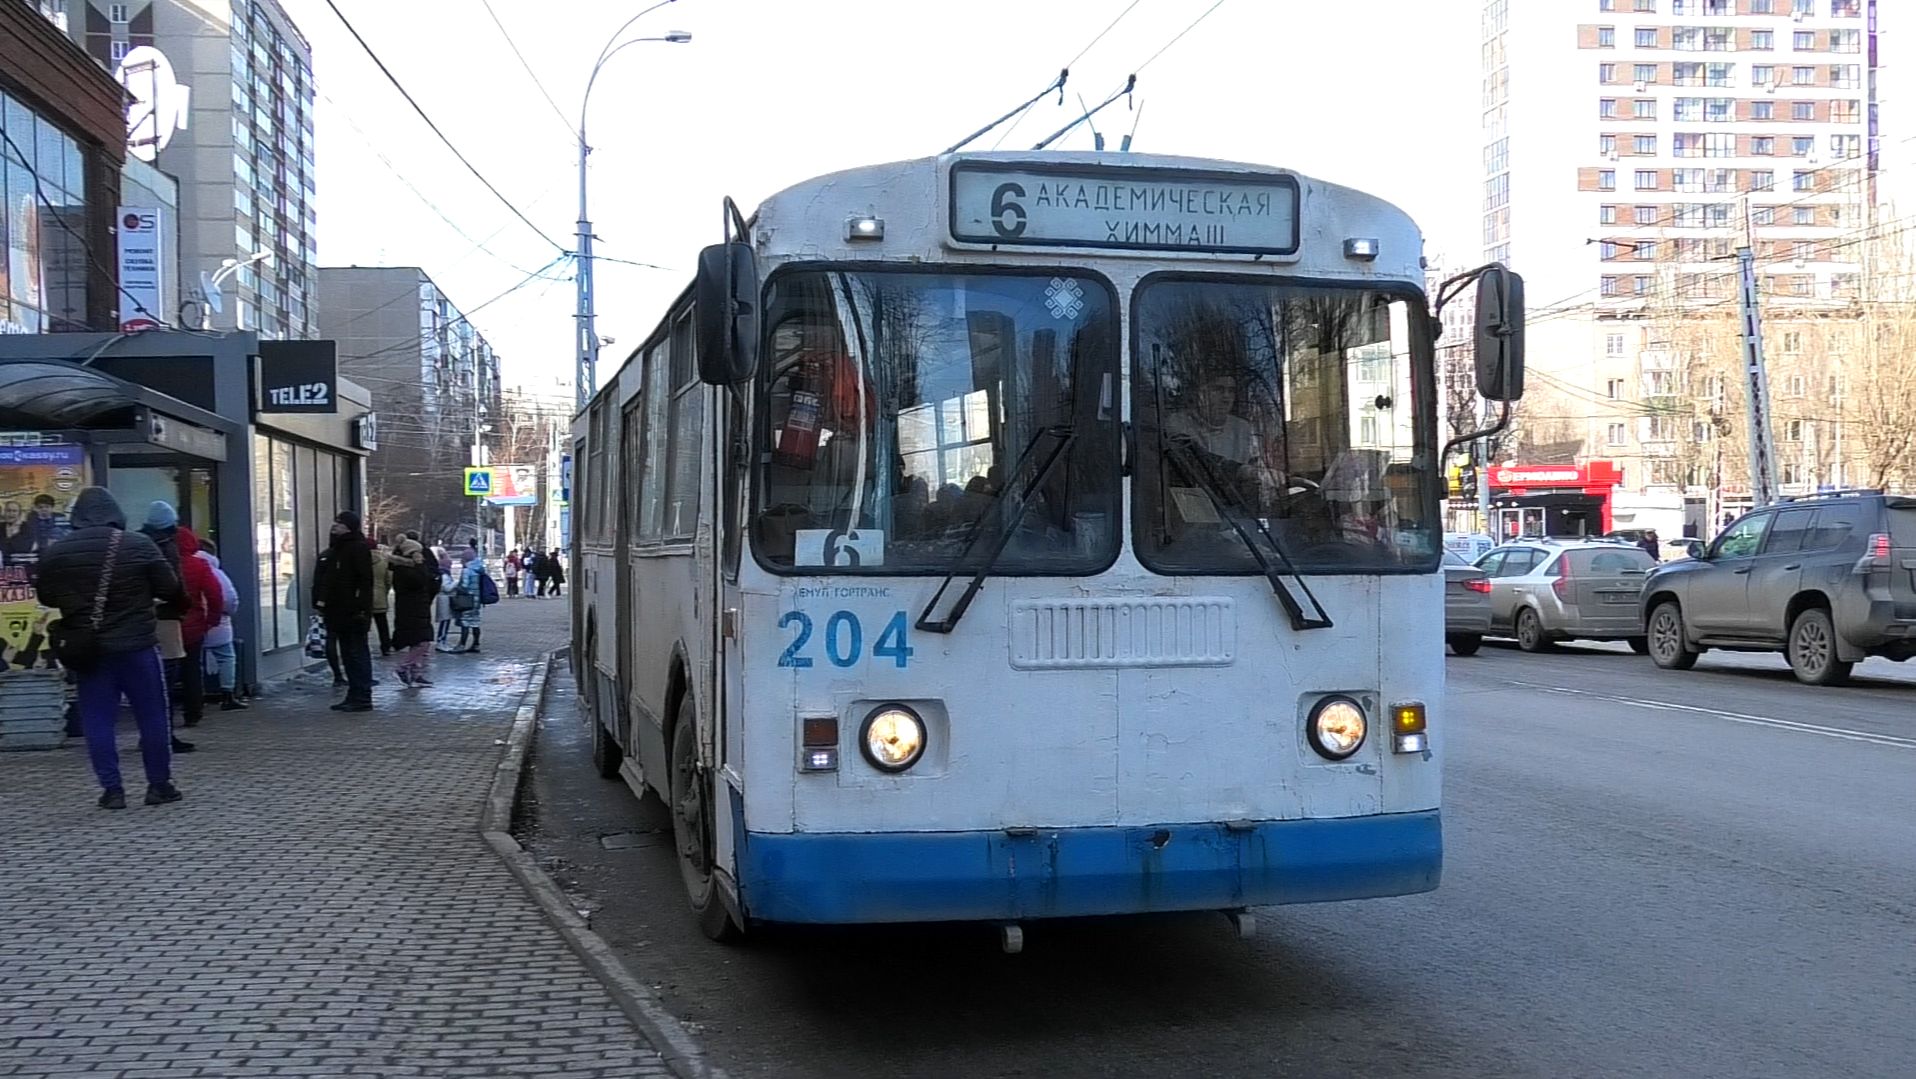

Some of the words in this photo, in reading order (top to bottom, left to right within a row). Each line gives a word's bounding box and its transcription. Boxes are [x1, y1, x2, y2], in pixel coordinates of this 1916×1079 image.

[991, 182, 1026, 239] 6
[1036, 182, 1271, 216] АКАДЕМИЧЕСКАЯ
[1105, 220, 1225, 245] ХИММАШ
[269, 382, 328, 405] TELE2
[823, 529, 860, 566] 6
[834, 587, 890, 598] ГОРТРАНС
[777, 610, 914, 668] 204
